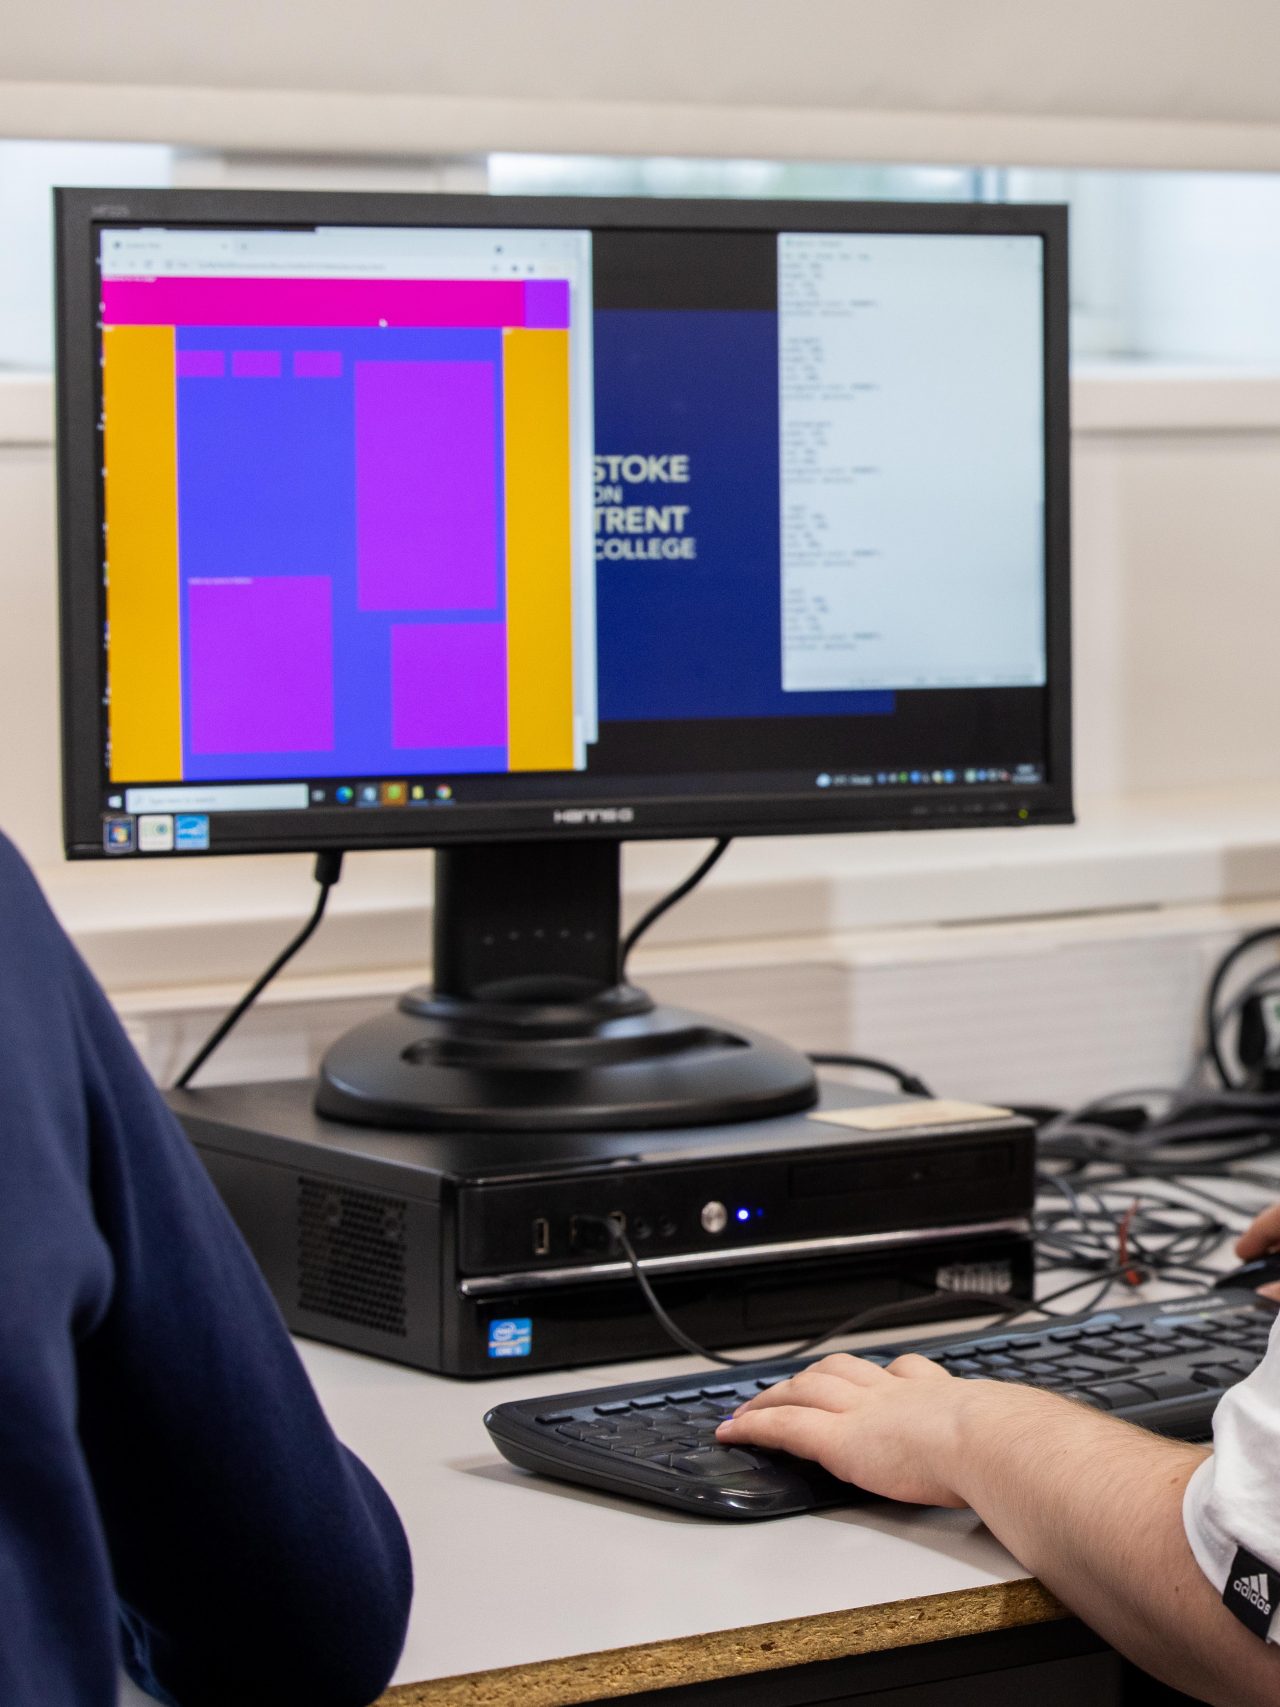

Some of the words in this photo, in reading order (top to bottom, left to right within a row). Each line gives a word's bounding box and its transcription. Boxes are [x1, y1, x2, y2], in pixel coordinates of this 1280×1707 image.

[594, 454, 690, 483] STOKE
[594, 505, 690, 534] TRENT
[594, 537, 697, 561] COLLEGE
[1233, 1580, 1272, 1616] adidas
